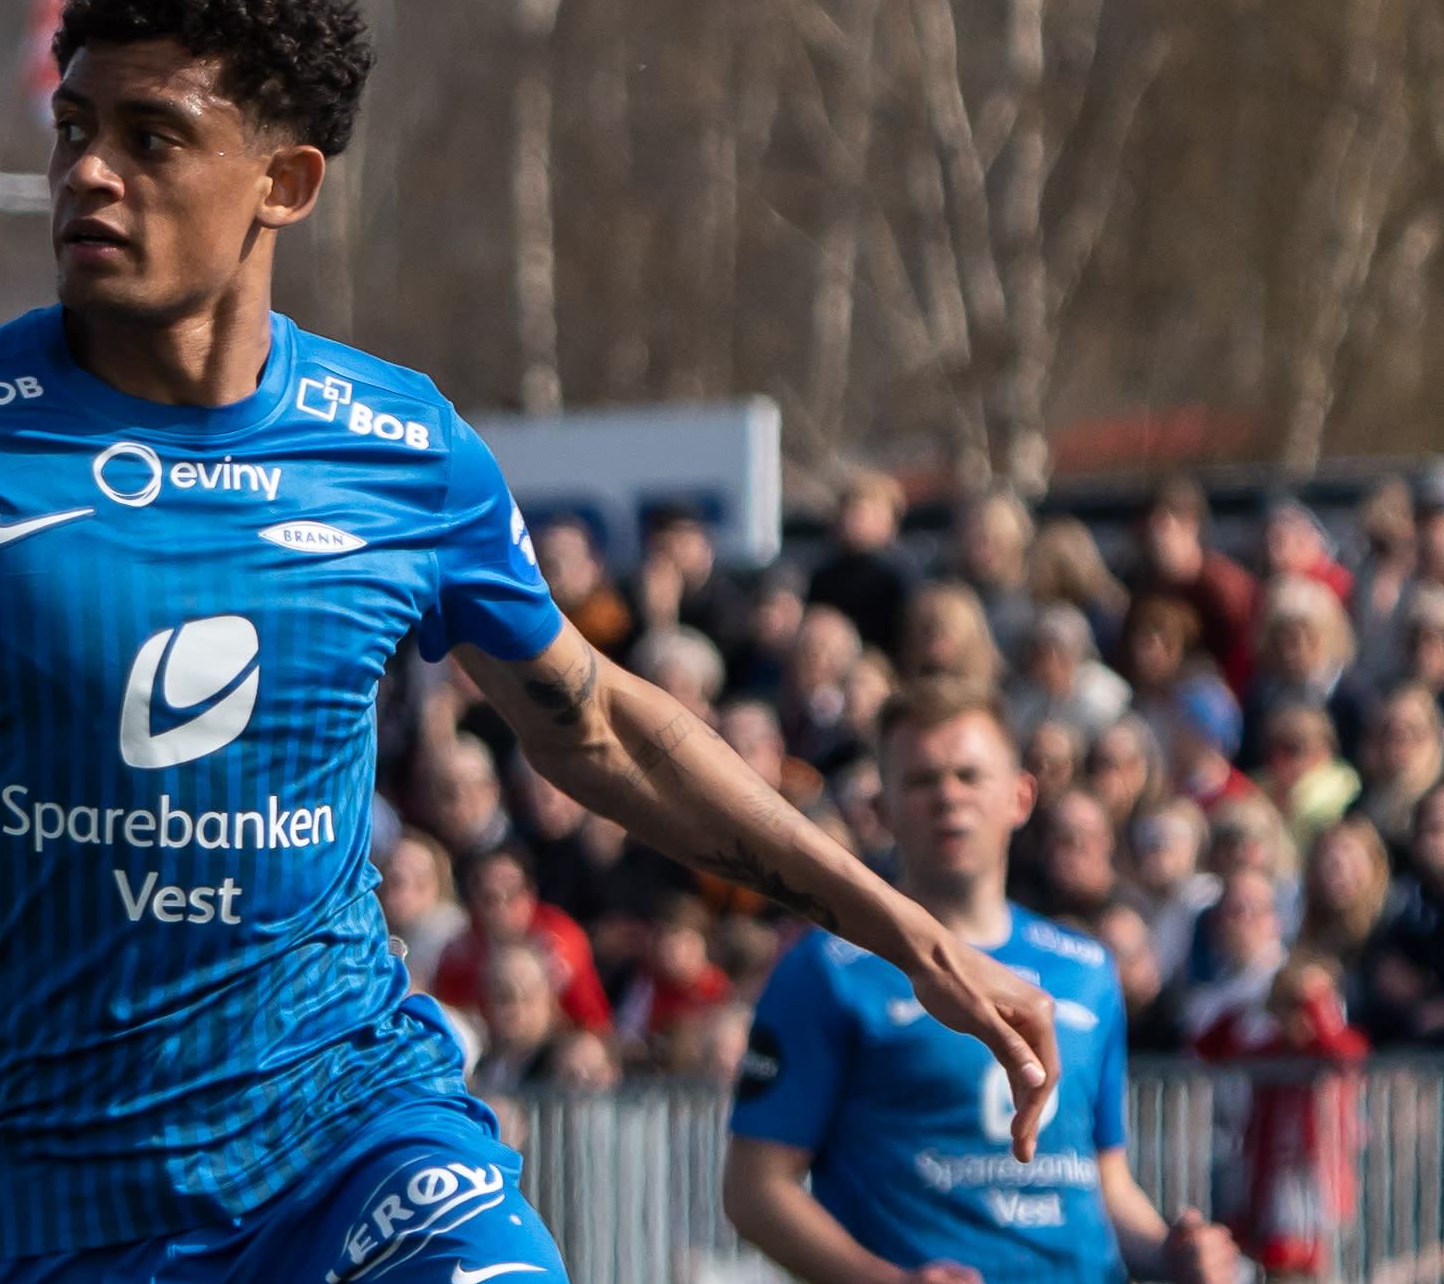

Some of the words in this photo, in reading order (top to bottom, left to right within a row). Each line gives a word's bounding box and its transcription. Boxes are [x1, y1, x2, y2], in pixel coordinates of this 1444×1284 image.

[349, 401, 430, 450] BOB
[170, 454, 282, 501] eviny
[283, 528, 345, 546] BRANN
[1, 783, 335, 853] Sparebanken
[113, 869, 243, 925] Vest
[325, 1162, 487, 1284] ERØY
